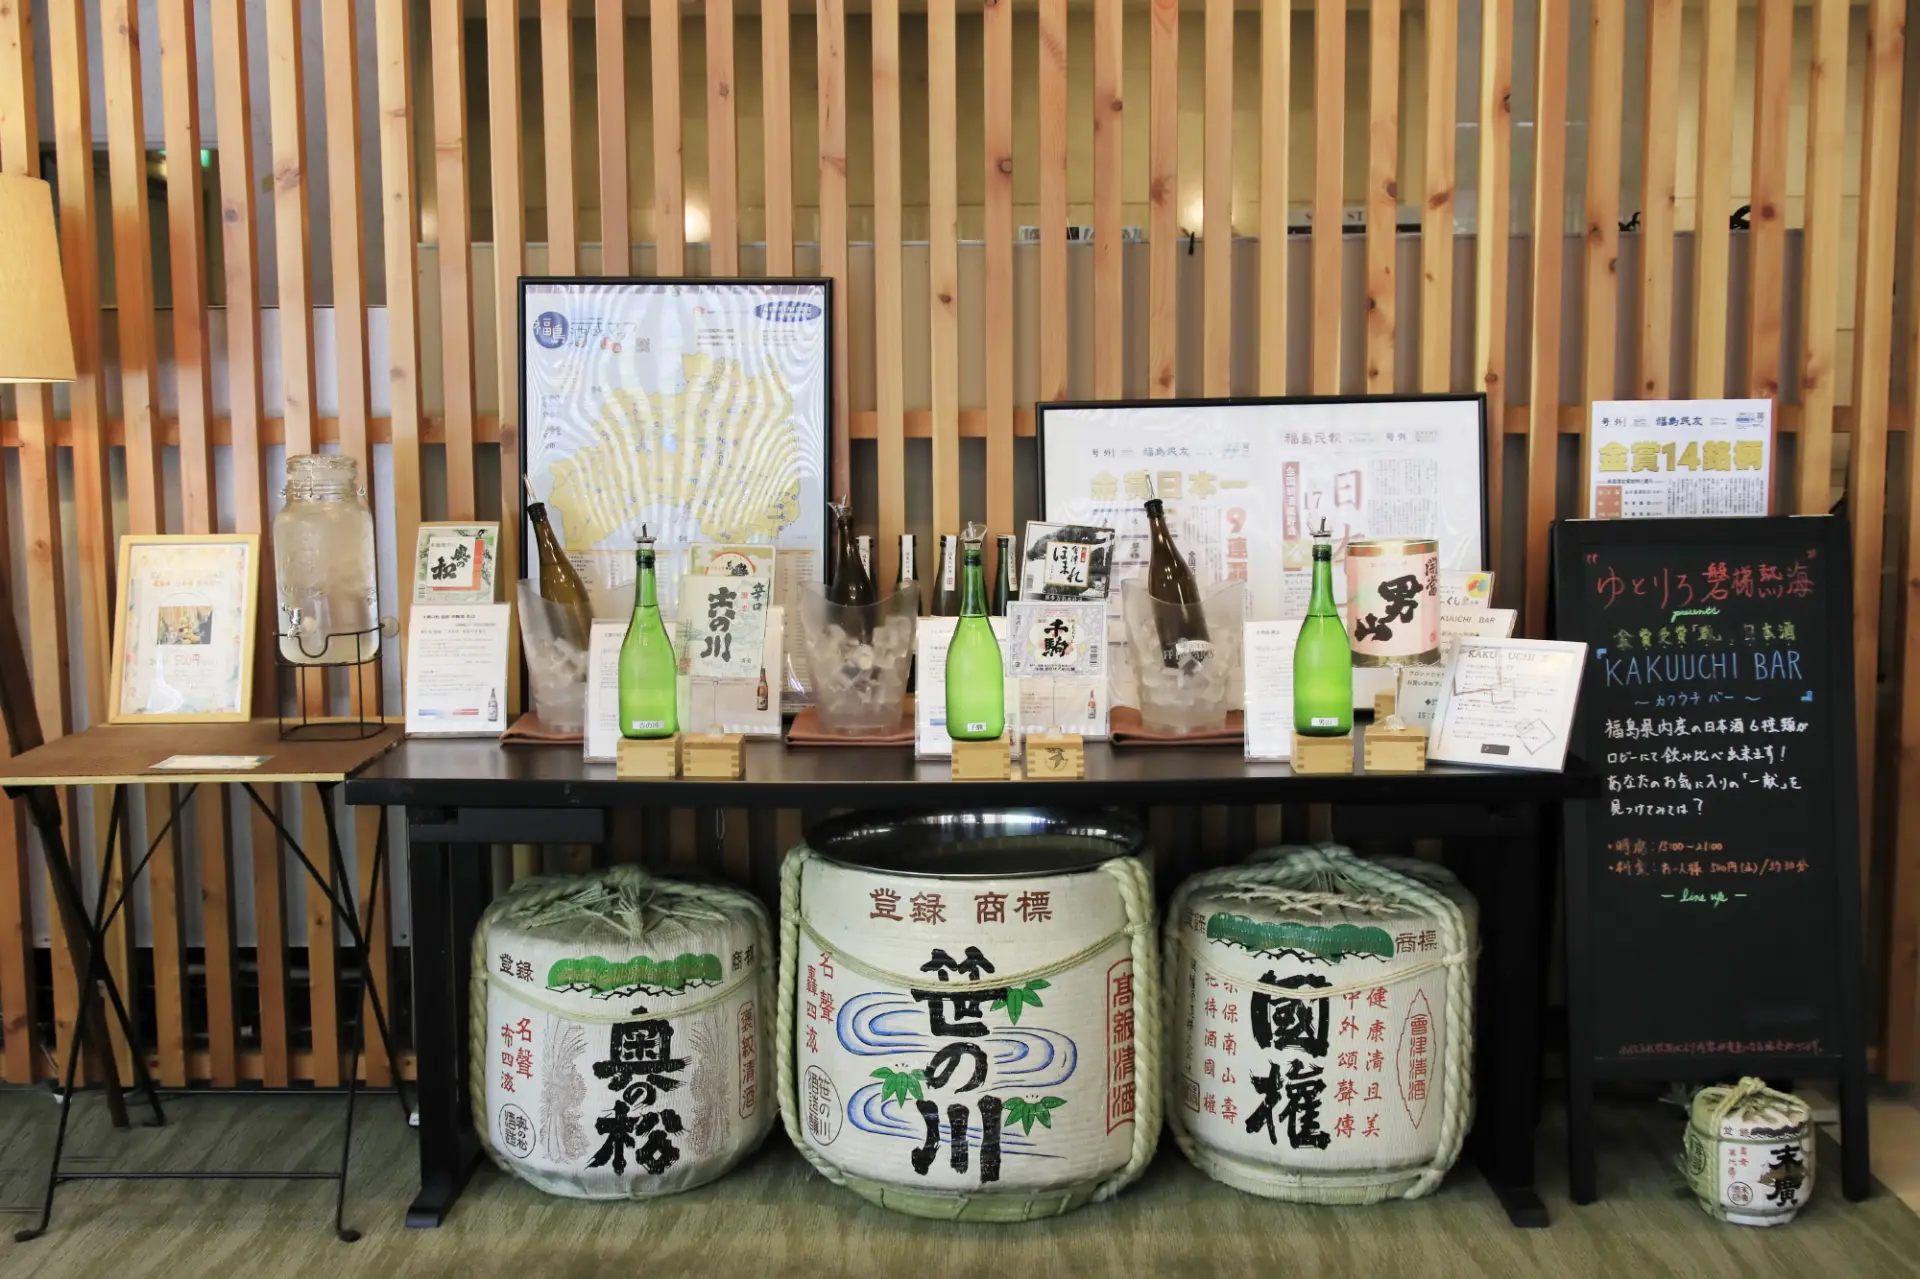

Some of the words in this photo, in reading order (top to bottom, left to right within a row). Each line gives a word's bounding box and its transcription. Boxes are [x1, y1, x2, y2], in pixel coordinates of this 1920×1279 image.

[533, 317, 566, 344] 福島
[1602, 416, 1625, 427] 号外
[1656, 416, 1704, 427] 福島民友
[1092, 448, 1111, 459] 号外
[1142, 446, 1190, 458] 福島民友
[1284, 431, 1342, 446] 福島民報
[1386, 432, 1407, 442] 号外
[1598, 440, 1765, 474] 金賞14銘柄
[1090, 470, 1249, 501] 金賞日本一
[430, 543, 472, 581] 奥の松
[750, 582, 766, 611] 辛口
[1353, 574, 1424, 642] 男山
[1478, 616, 1496, 624] BAR
[1467, 650, 1496, 660] KAKU
[1605, 652, 1738, 688] KAKUUCHI
[1754, 651, 1802, 681] BAR
[869, 888, 947, 926] 登録
[974, 890, 1053, 924] 商標
[1680, 888, 1707, 903] line
[1710, 891, 1728, 908] up
[1395, 930, 1438, 954] 商標
[910, 945, 1009, 1184] 笹の川
[583, 1005, 694, 1177] 奥の松
